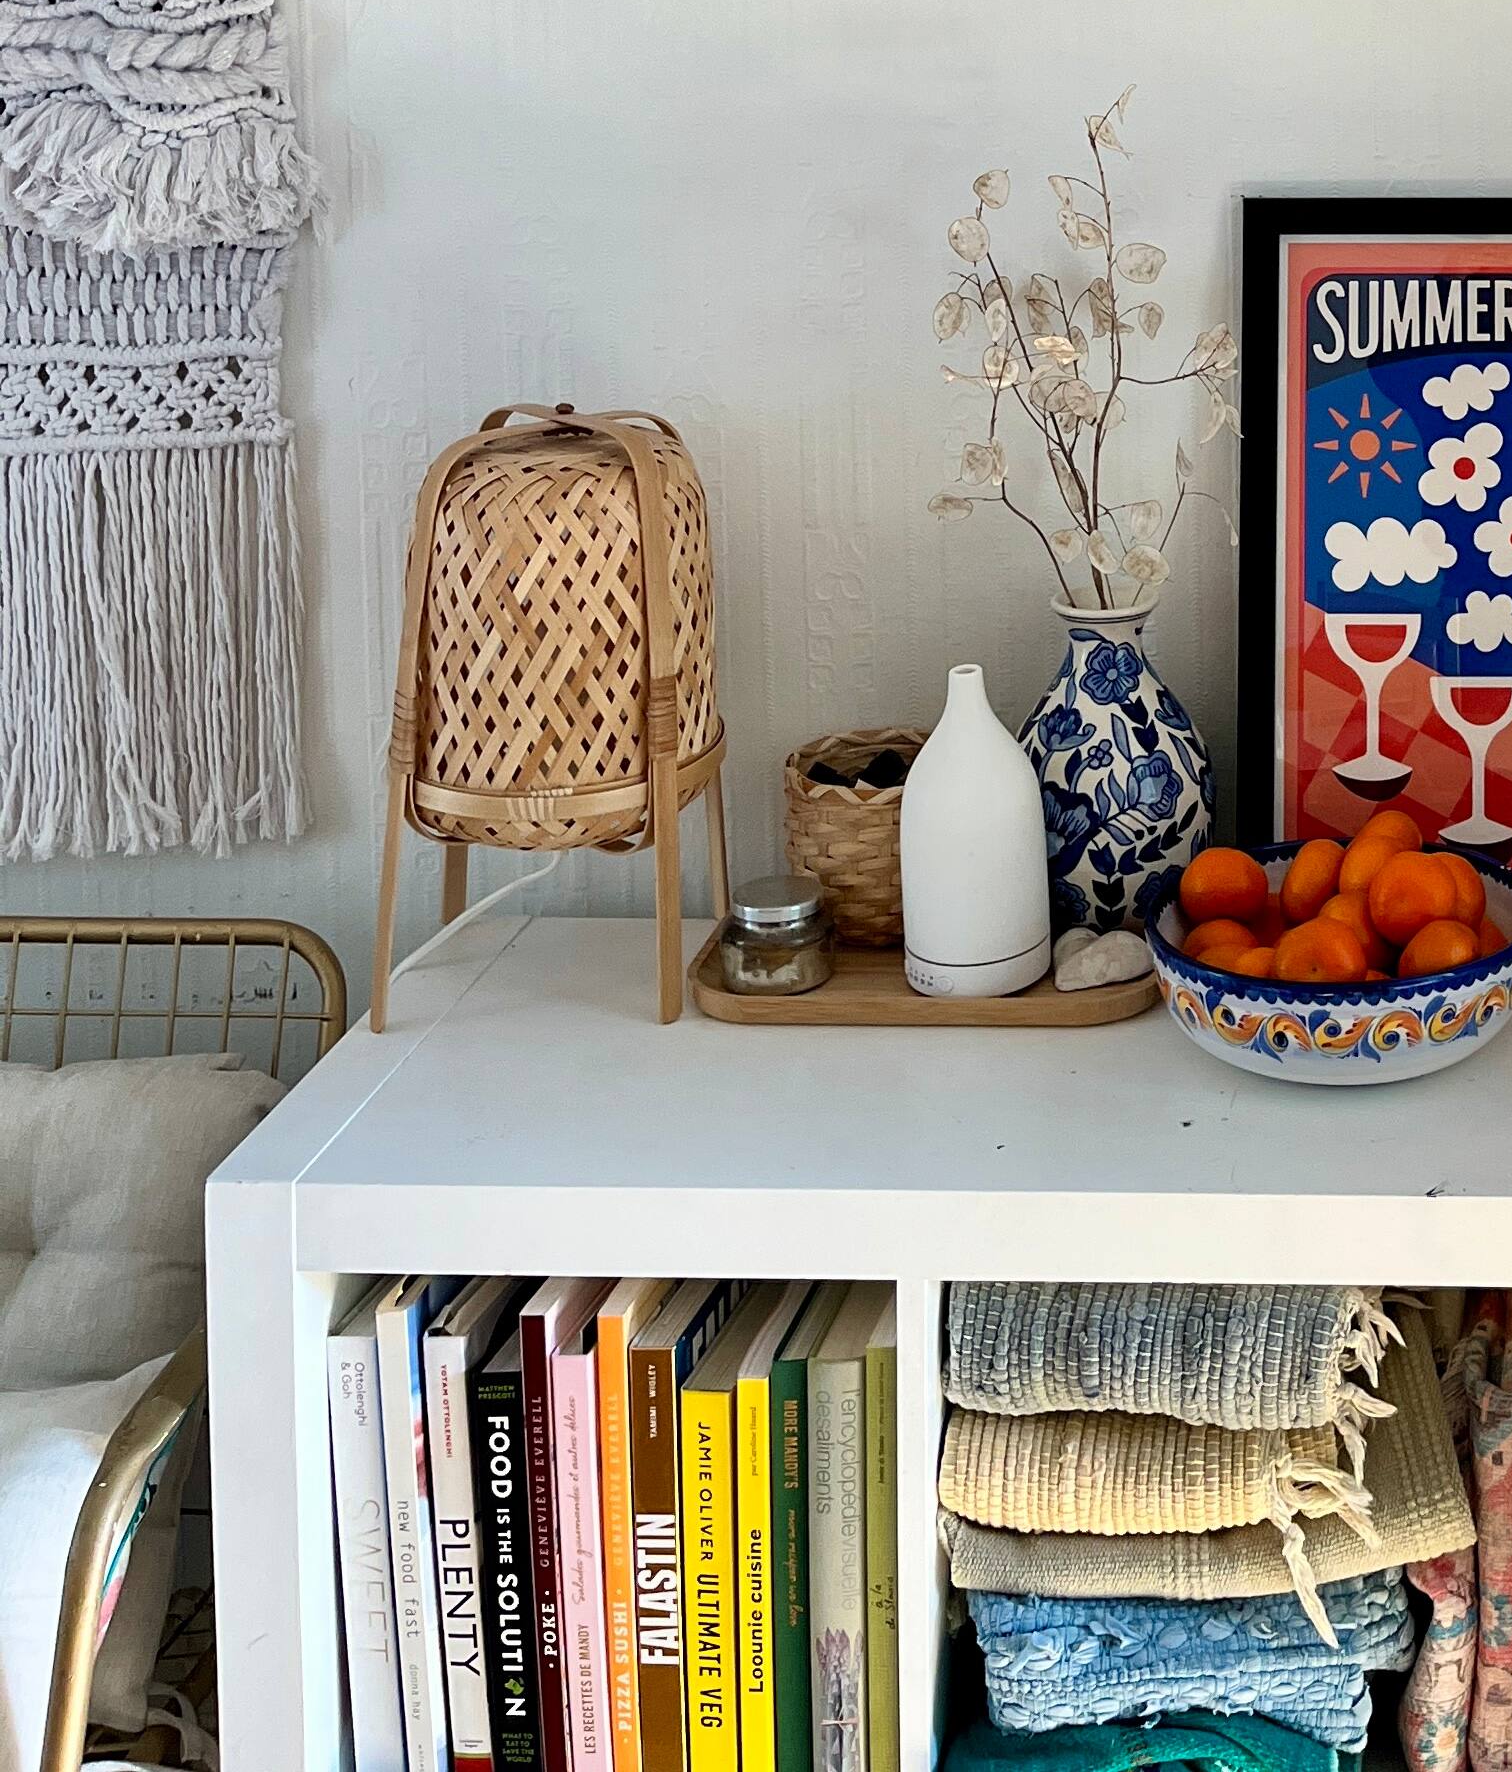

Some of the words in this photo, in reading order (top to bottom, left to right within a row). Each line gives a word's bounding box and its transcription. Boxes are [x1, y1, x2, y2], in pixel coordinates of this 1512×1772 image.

[342, 1373, 352, 1400] Goh
[354, 1362, 368, 1426] Ottolenghi
[440, 1365, 449, 1396] YOTAM
[443, 1399, 453, 1459] OTTOLENGHI
[531, 1396, 545, 1466] EVERELL
[784, 1400, 799, 1433] MORE
[488, 1416, 513, 1499] FOOD
[698, 1422, 713, 1481] JAMIE
[784, 1437, 799, 1489] MANDY'S
[397, 1501, 409, 1533] new
[497, 1509, 511, 1525] IS
[535, 1475, 550, 1568] GENEVIÈVE
[700, 1489, 714, 1561] OLIVER
[400, 1543, 417, 1584] food
[498, 1530, 513, 1564] THE
[747, 1529, 764, 1604] cuisine
[353, 1499, 389, 1663] SWEET
[440, 1519, 481, 1677] PLENTY
[636, 1514, 680, 1665] FALASTIN
[404, 1598, 421, 1638] fast
[541, 1603, 558, 1657] POKE
[578, 1624, 591, 1661] MANDY
[612, 1601, 630, 1665] SUSHI
[697, 1574, 722, 1678] ULTIMATE
[580, 1664, 591, 1678] DE
[749, 1613, 764, 1693] Loounie
[409, 1664, 420, 1696] donna
[616, 1672, 633, 1732] PIZZA
[411, 1699, 421, 1721] hay
[581, 1681, 595, 1733] RECETTES
[700, 1688, 723, 1729] VEG
[585, 1735, 596, 1755] LES
